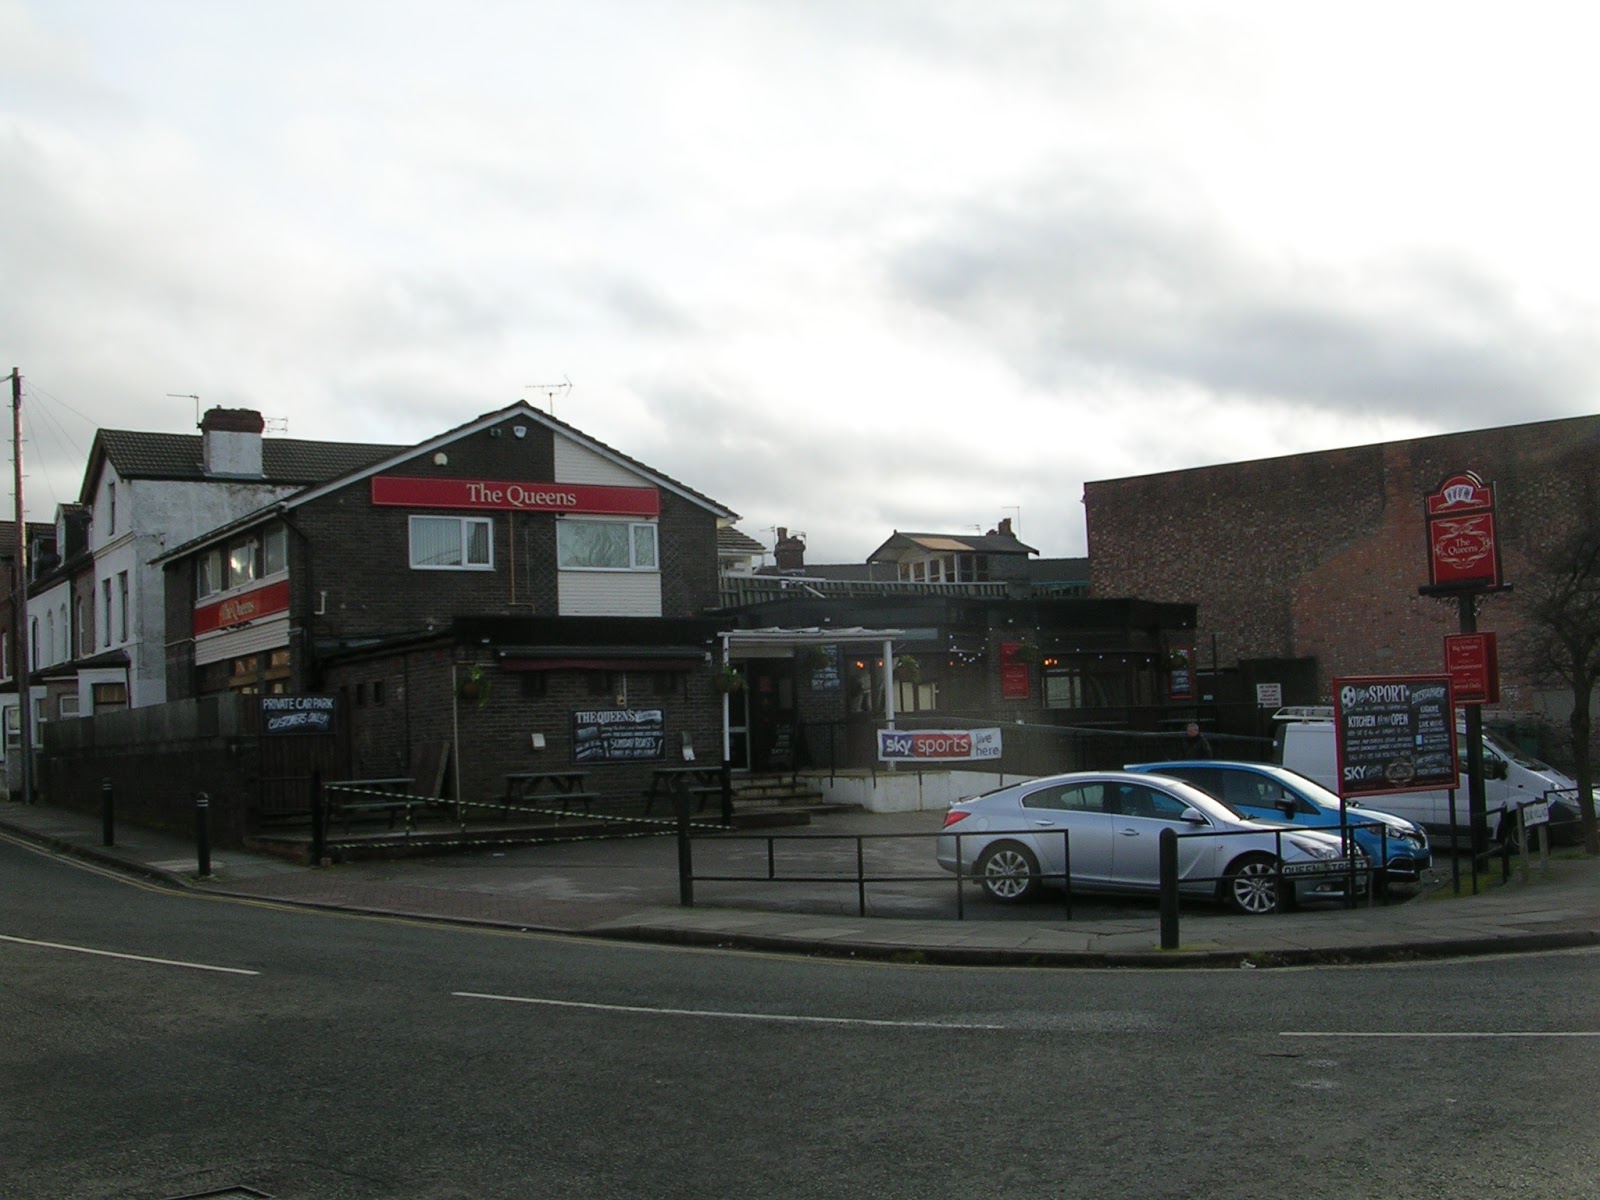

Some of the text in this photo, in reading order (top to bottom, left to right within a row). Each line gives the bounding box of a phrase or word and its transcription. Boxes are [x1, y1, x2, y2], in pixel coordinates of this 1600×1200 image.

[466, 483, 577, 507] The Queens
[1448, 538, 1478, 556] The Queens
[1369, 684, 1406, 703] SPORT
[263, 697, 334, 710] PRIVATE CAR PARK
[575, 711, 596, 723] THE
[1348, 715, 1376, 728] KITCHEN
[1390, 713, 1409, 726] OPEN
[886, 736, 968, 756] sky sports
[976, 733, 992, 744] live
[976, 745, 999, 757] here
[1344, 765, 1366, 780] SKY
[1284, 864, 1320, 874] QUEEN
